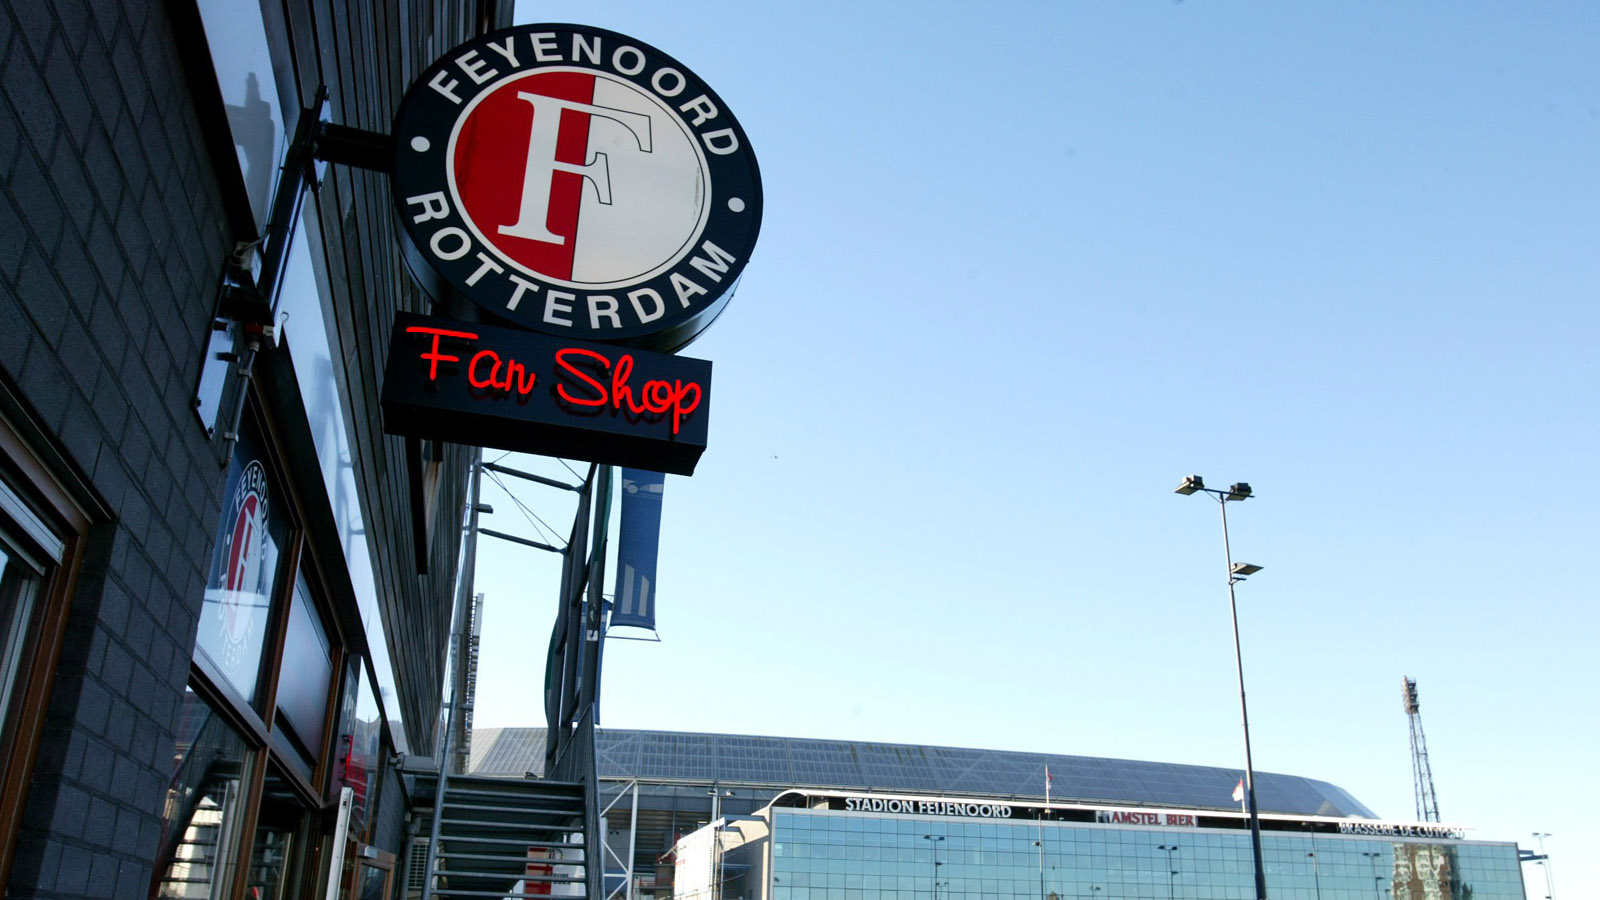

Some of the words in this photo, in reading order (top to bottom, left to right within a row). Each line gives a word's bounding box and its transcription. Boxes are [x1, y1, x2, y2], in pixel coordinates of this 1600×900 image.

[428, 32, 739, 155] FEYENOORD
[497, 90, 652, 245] F
[406, 190, 736, 329] ROTTERDAM
[406, 326, 535, 395] Fan
[555, 348, 702, 435] Shop
[845, 797, 914, 813] STADION
[918, 800, 1012, 818] FEIJENOORD
[1111, 811, 1162, 825] AMSTEL
[1166, 813, 1194, 826] BIER
